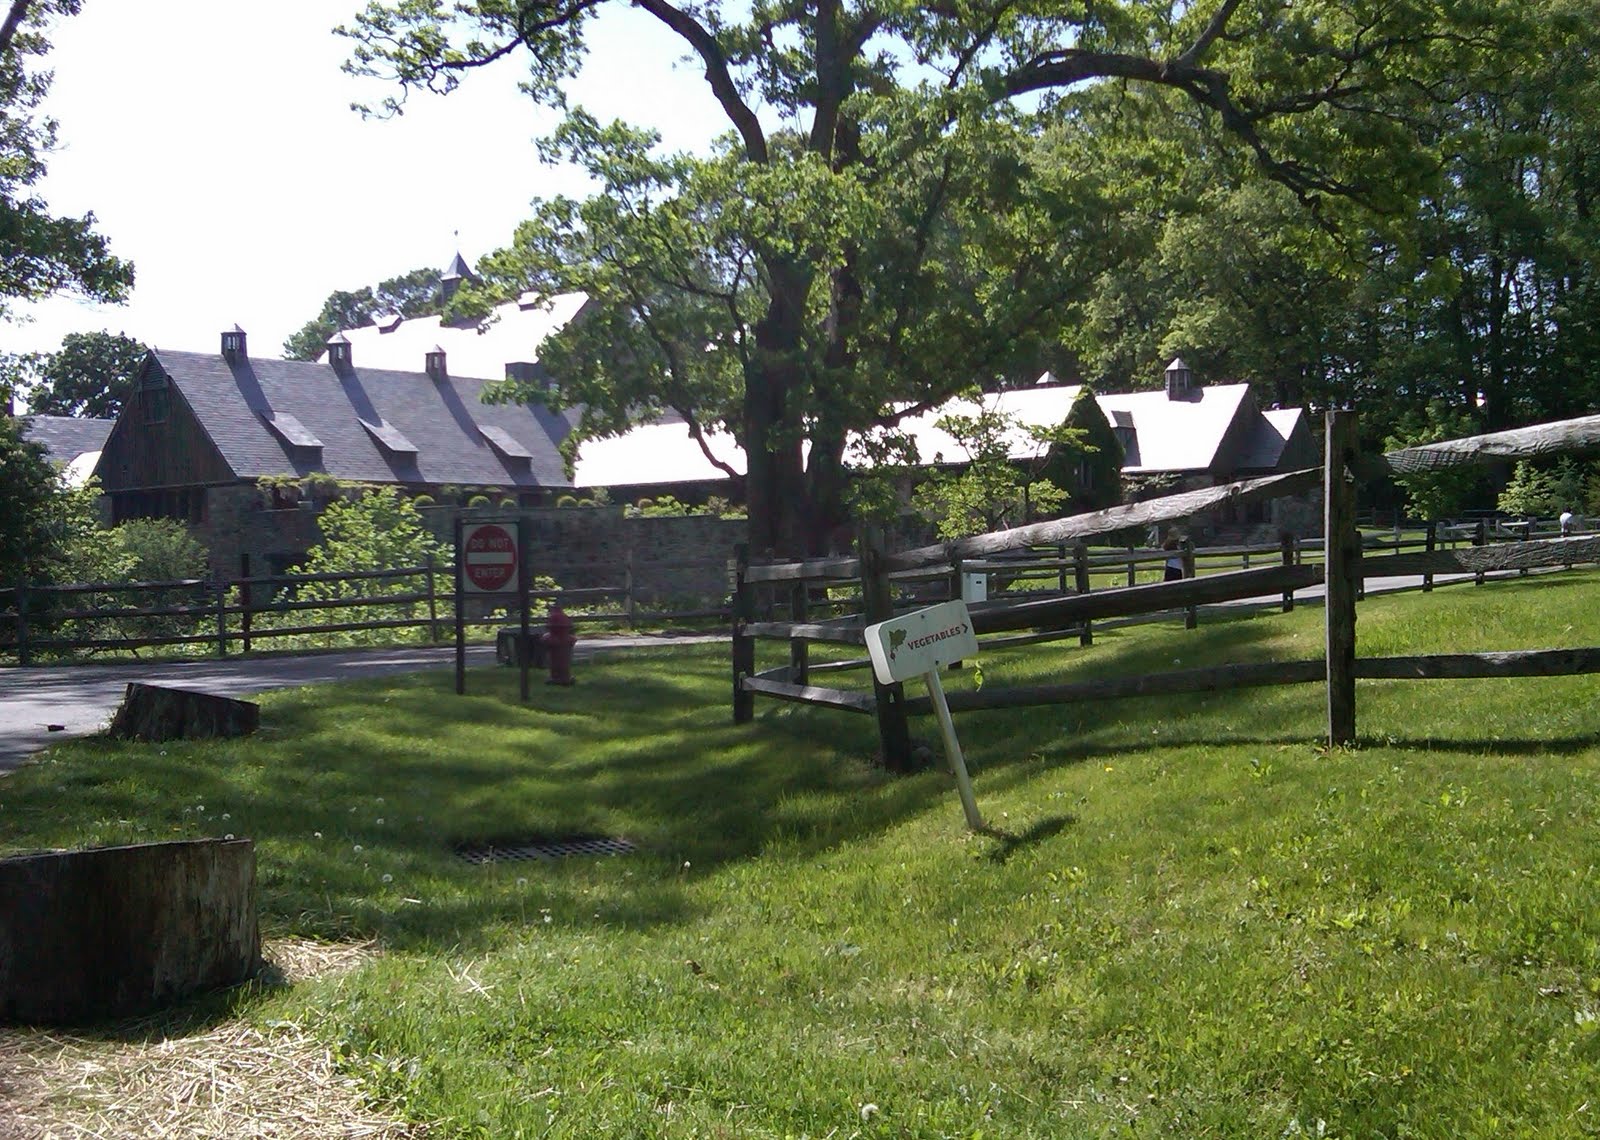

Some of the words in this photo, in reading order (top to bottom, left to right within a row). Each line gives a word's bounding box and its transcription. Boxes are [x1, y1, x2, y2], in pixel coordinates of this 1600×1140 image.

[471, 538, 486, 549] DO
[488, 537, 509, 549] NOT
[474, 567, 505, 578] ENTER
[907, 626, 961, 650] VEGETABLES
